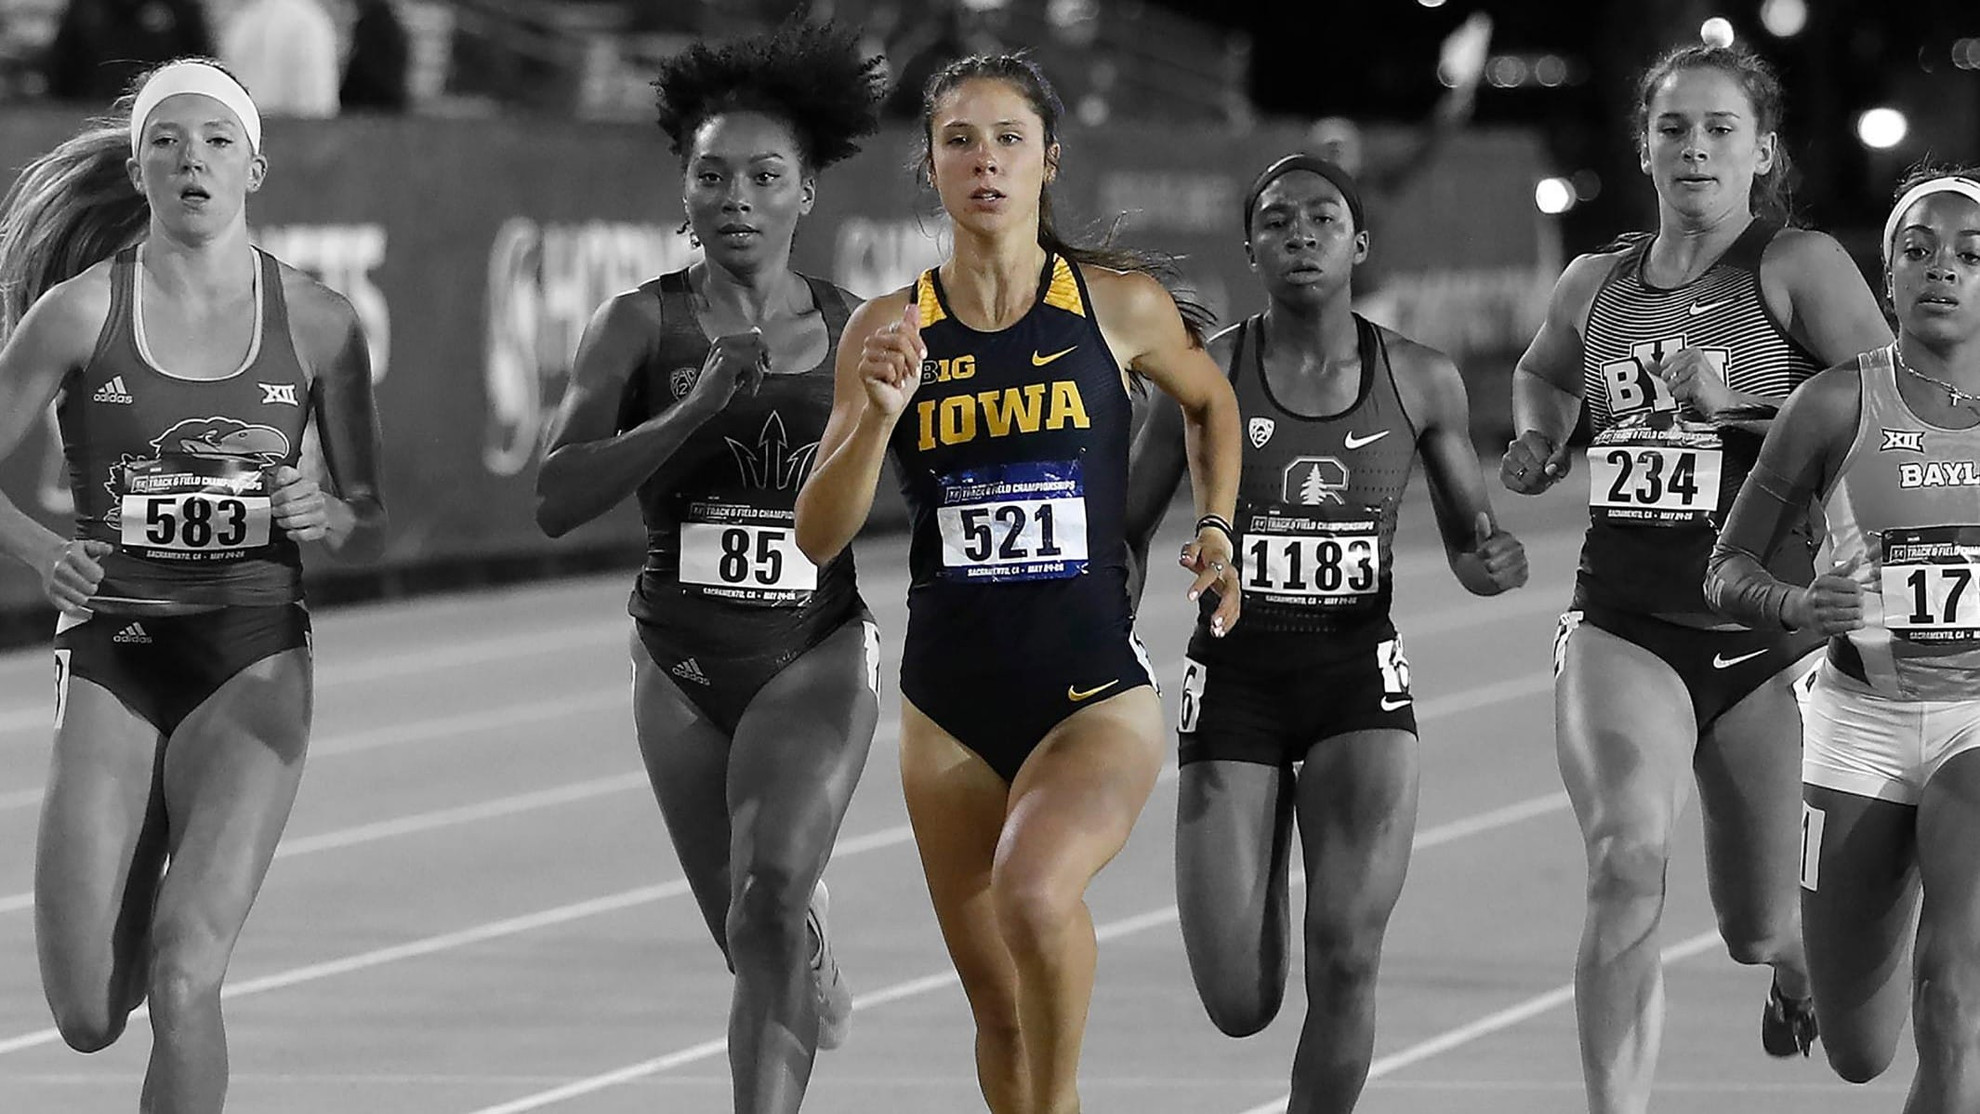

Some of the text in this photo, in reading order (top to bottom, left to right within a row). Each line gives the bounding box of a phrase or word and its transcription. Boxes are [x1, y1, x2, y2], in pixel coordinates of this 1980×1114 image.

[1602, 336, 1731, 416] BY
[93, 393, 133, 404] adidas
[917, 380, 1091, 452] IOWA
[1881, 429, 1926, 452] XII
[149, 478, 173, 487] TRACK
[179, 476, 201, 486] FIELD
[1012, 480, 1076, 493] CHAMPIONSHIPS
[1606, 450, 1699, 505] 234
[146, 497, 247, 548] 583
[706, 507, 730, 516] TRACK
[737, 508, 758, 518] FIELD
[960, 504, 1062, 562] 521
[719, 528, 786, 585] 85
[1250, 541, 1374, 591] 1183
[1907, 547, 1931, 558] TRACK
[1938, 545, 1961, 557] FIELD
[1907, 568, 1971, 624] 17
[113, 635, 152, 644] adidas
[672, 667, 711, 686] adidas
